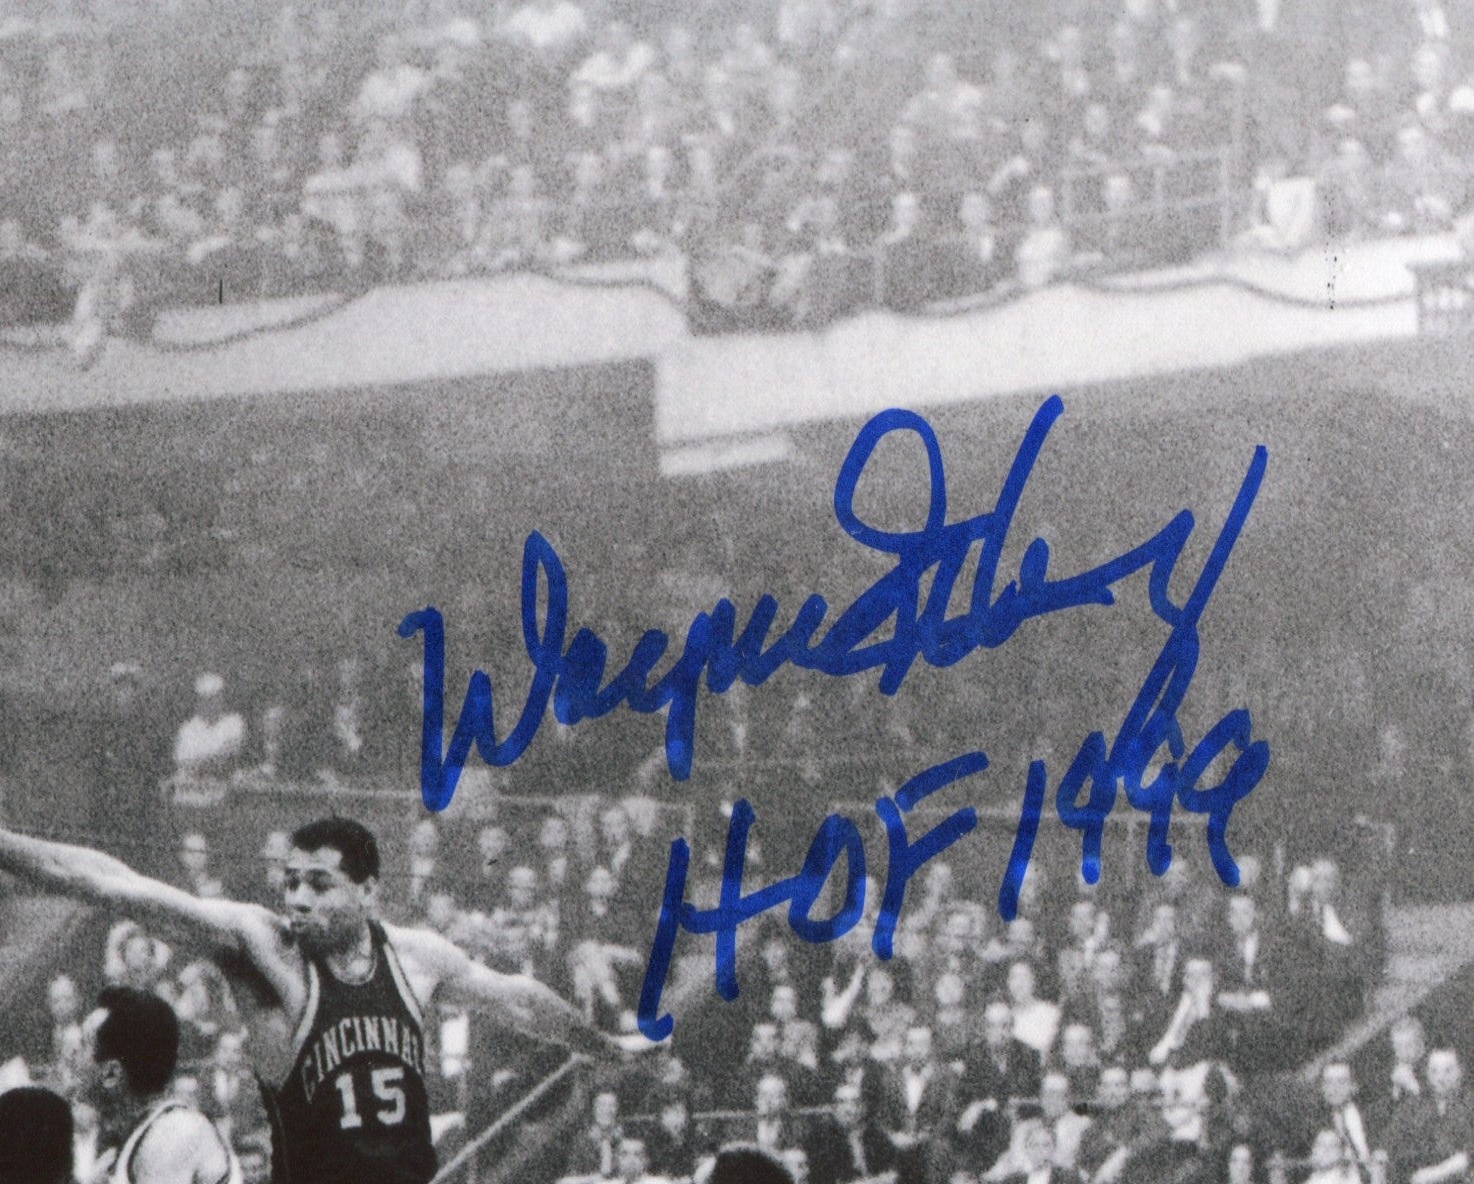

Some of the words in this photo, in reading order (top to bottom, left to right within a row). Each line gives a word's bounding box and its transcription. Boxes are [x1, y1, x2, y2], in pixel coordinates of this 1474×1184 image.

[637, 752, 988, 1041] HOF
[998, 706, 1270, 922] 1999
[335, 1066, 406, 1129] 15
